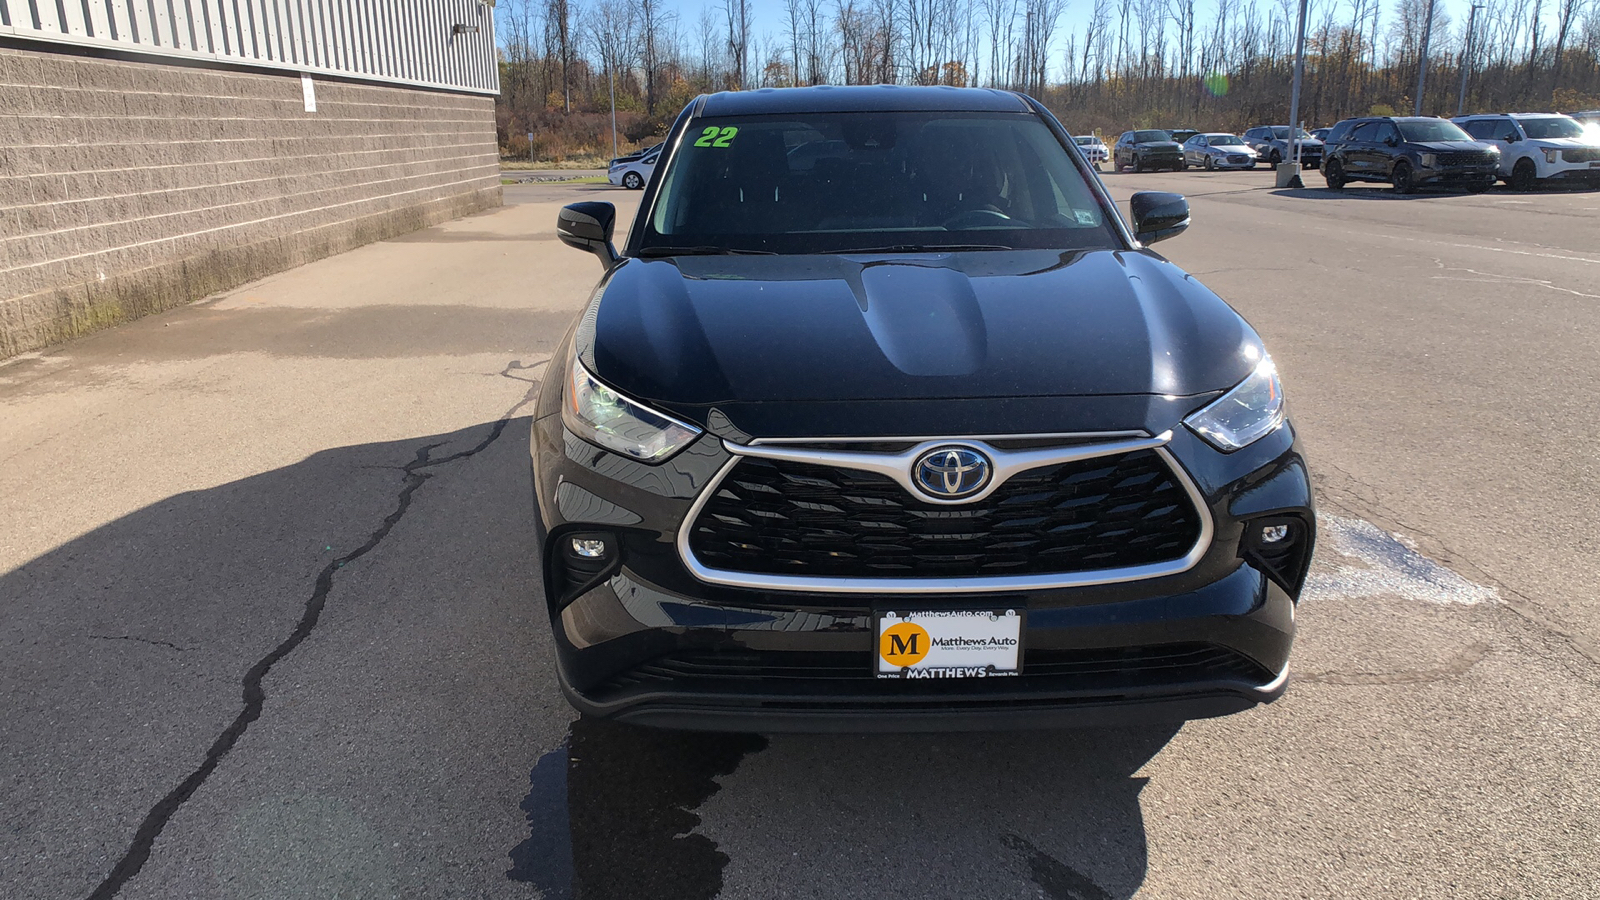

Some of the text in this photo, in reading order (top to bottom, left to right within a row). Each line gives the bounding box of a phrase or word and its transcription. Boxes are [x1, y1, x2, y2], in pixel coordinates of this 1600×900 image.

[694, 126, 738, 148] 22
[908, 610, 994, 618] MatthewsAuto.com
[886, 632, 921, 656] M
[931, 636, 1017, 647] Matthews Auto
[906, 667, 987, 679] MATTHEWS
